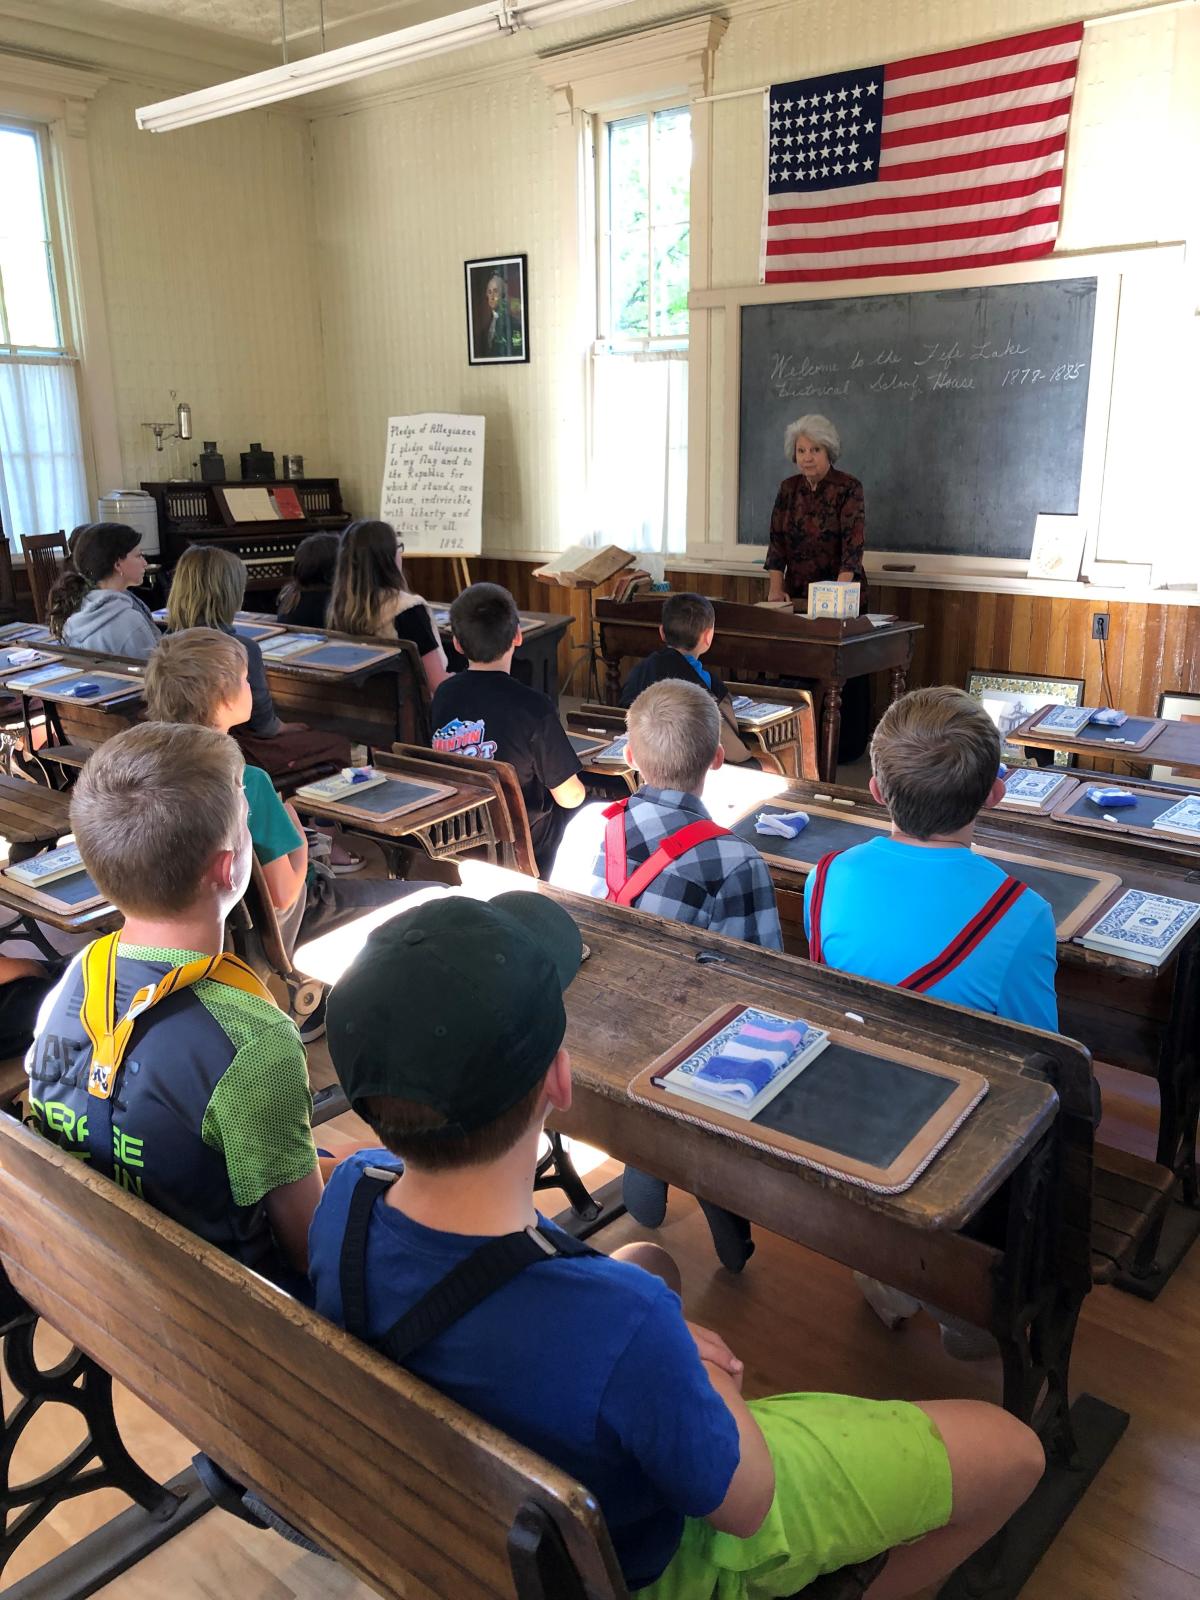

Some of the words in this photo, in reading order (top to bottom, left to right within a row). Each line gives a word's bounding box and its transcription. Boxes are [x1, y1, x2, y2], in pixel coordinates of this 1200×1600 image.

[770, 352, 839, 380] Welcome
[850, 351, 865, 369] to
[870, 349, 902, 365] the
[913, 342, 964, 369] Fife
[969, 338, 1031, 360] Lake
[869, 372, 921, 401] School
[927, 371, 976, 391] House
[390, 424, 416, 439] Pledge
[419, 423, 428, 434] of
[429, 423, 477, 437] Allegiance
[390, 443, 396, 454] I
[399, 442, 424, 457] pledge
[428, 441, 473, 454] allegiance
[390, 458, 398, 466] to
[403, 459, 414, 469] my
[441, 456, 459, 465] and
[463, 457, 473, 466] to
[388, 469, 401, 479] the
[407, 467, 445, 481] Republic
[385, 481, 409, 492] which
[411, 482, 419, 491] it
[459, 484, 473, 492] one
[384, 508, 404, 518] with
[410, 507, 447, 520] liberty
[452, 508, 470, 518] and
[394, 520, 419, 531] stice
